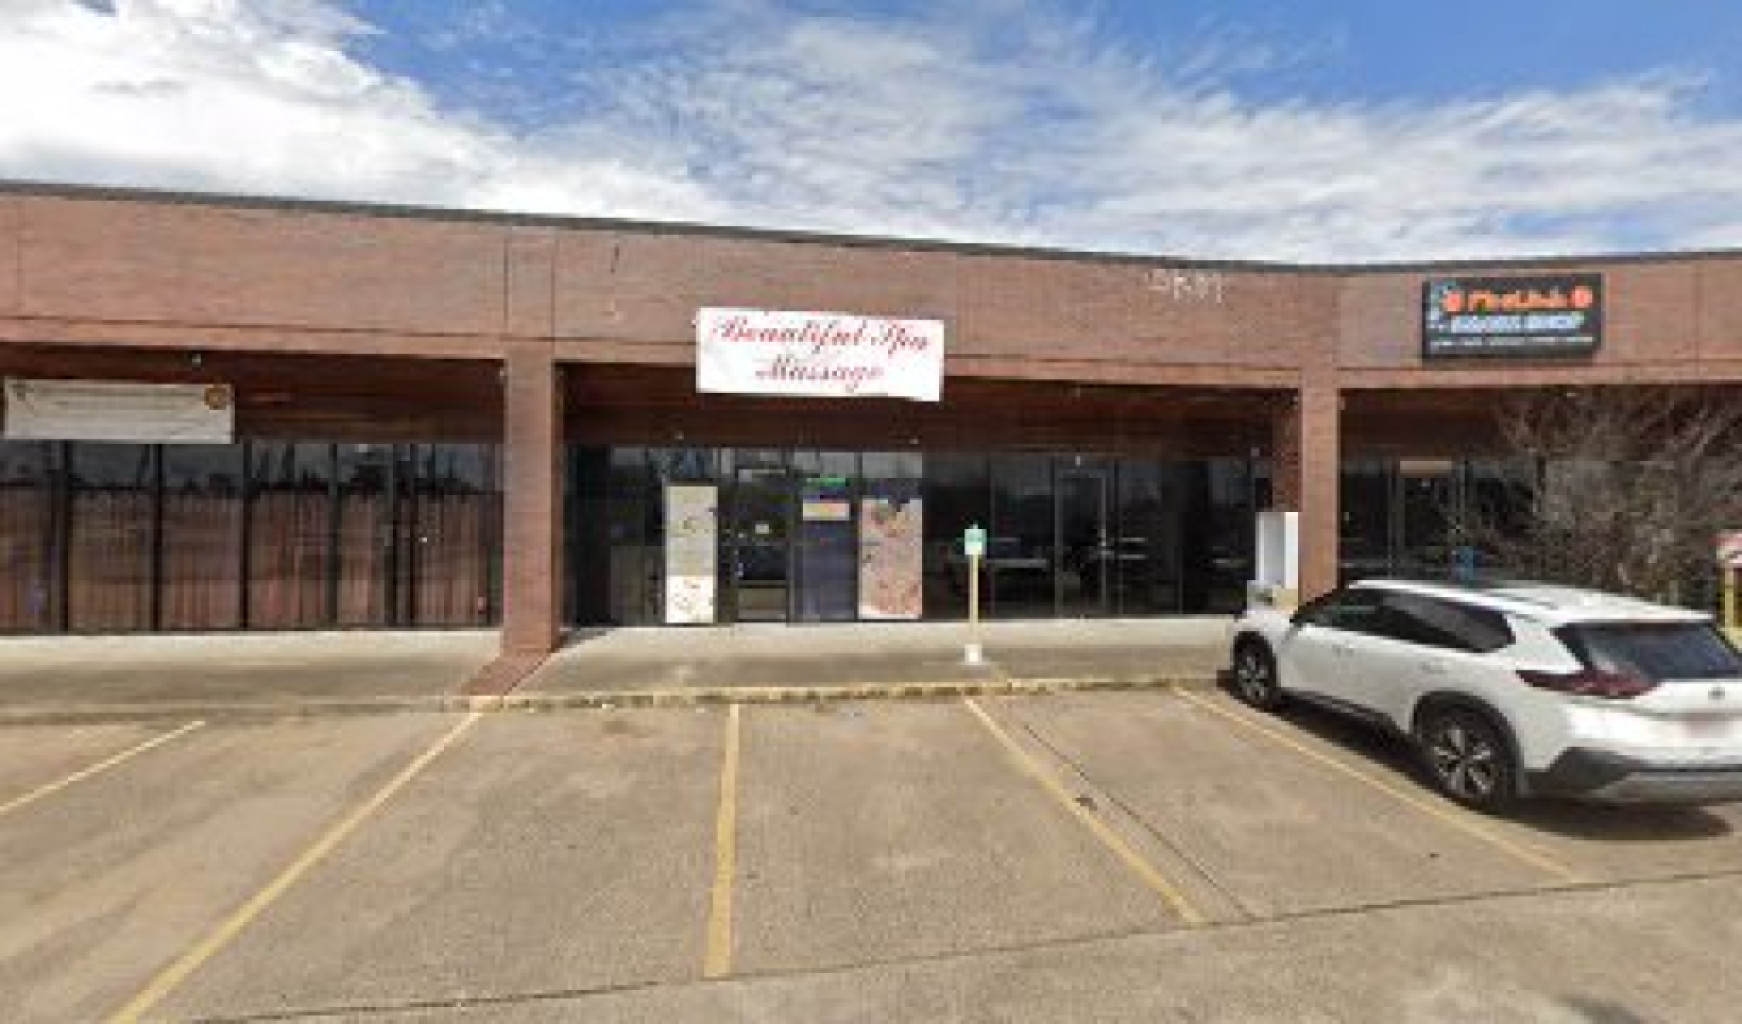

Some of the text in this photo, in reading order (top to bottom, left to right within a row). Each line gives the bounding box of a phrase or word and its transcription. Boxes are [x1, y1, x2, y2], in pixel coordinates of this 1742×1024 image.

[712, 316, 928, 358] Beautiful Spa
[755, 354, 884, 393] Massage
